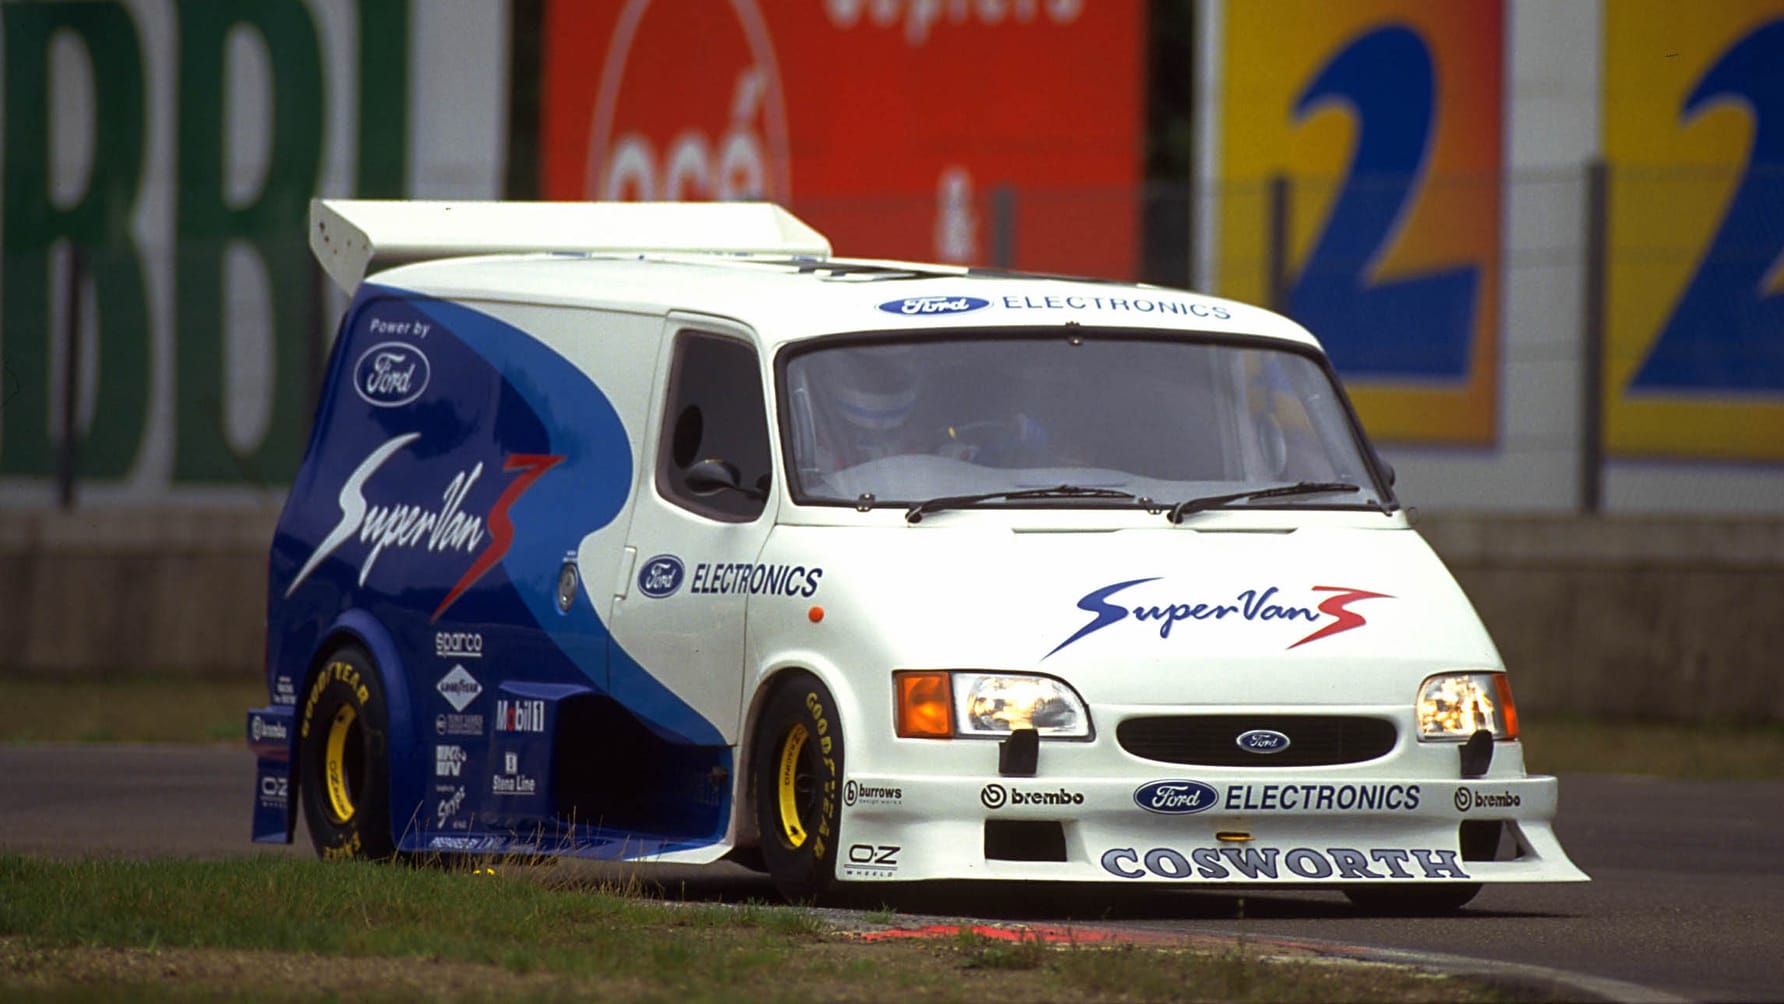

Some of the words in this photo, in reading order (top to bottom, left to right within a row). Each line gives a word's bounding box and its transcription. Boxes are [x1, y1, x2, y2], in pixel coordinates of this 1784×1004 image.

[1284, 22, 1483, 382] 2
[900, 297, 969, 315] Ford
[1003, 296, 1231, 320] ELECTRONICS
[370, 319, 411, 334] Power
[413, 319, 430, 337] by
[366, 353, 415, 394] Ford
[646, 563, 677, 589] Ford
[690, 563, 823, 598] ELECTRONICS
[436, 632, 482, 658] sparco
[496, 700, 532, 731] Mobil
[859, 783, 902, 799] burrows
[1011, 788, 1084, 805] brembo
[1151, 784, 1201, 809] Ford
[1225, 785, 1420, 810] ELECTRONICS
[1474, 791, 1521, 808] brembo
[1101, 848, 1470, 880] COSWORTH
